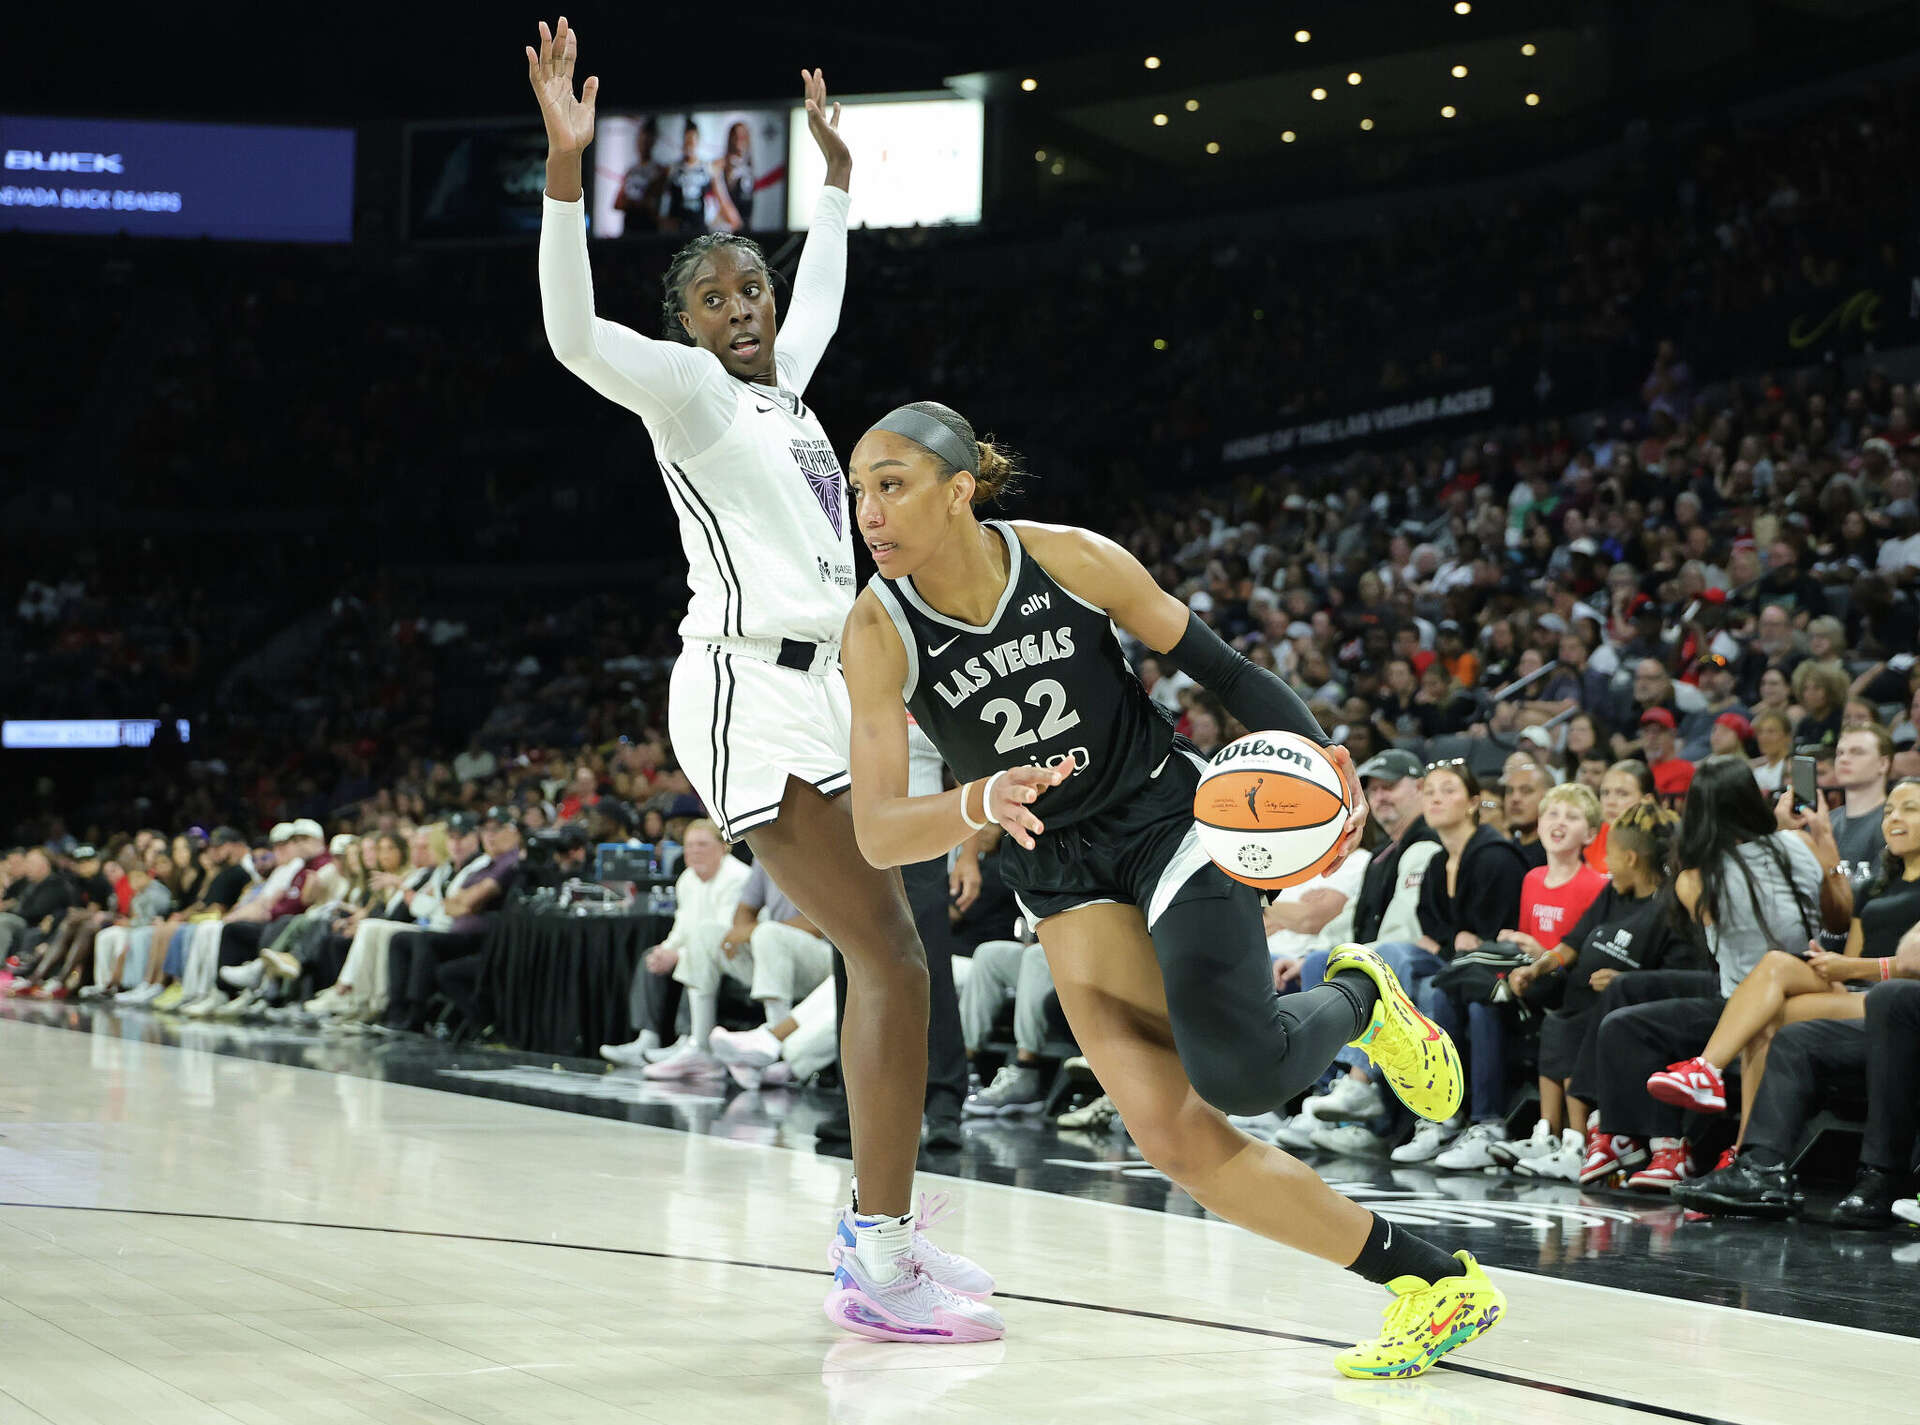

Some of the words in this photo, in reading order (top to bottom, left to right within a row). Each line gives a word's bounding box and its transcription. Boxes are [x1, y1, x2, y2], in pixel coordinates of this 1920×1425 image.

[5, 150, 124, 174] BUICK
[1020, 592, 1051, 616] ally
[933, 657, 991, 709] LAS
[983, 626, 1075, 677] VEGAS
[980, 678, 1080, 755] 22
[1213, 739, 1313, 772] Wilson
